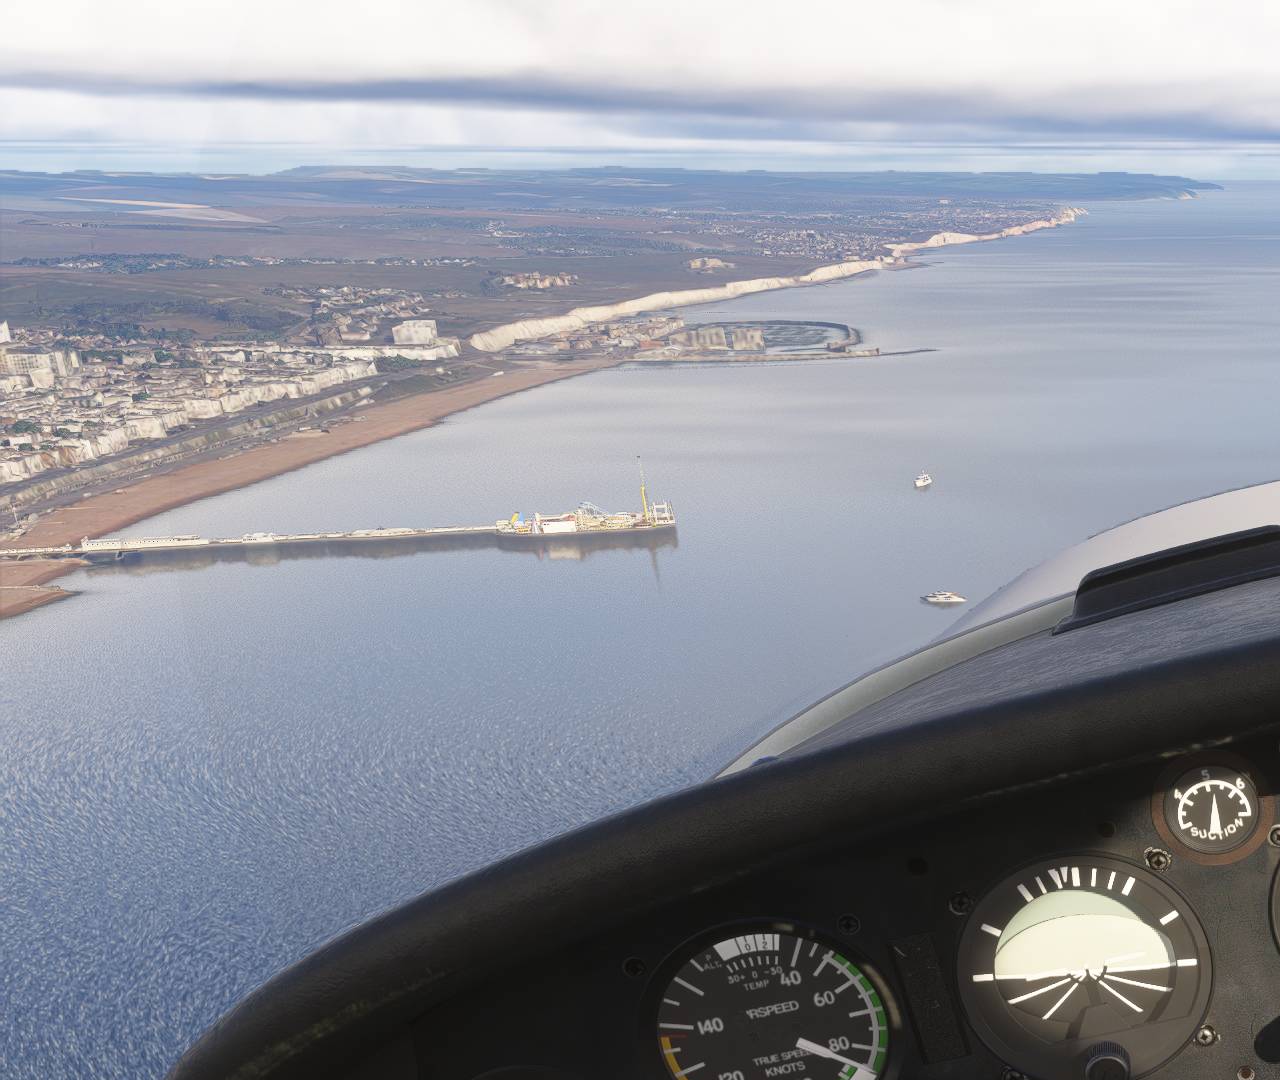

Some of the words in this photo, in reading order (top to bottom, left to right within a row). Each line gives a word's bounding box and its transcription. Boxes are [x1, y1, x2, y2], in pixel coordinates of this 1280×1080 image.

[780, 970, 801, 986] 40
[814, 991, 835, 1007] 60
[697, 1018, 723, 1035] 140
[829, 1036, 849, 1051] 80
[765, 1062, 806, 1077] KNOTS
